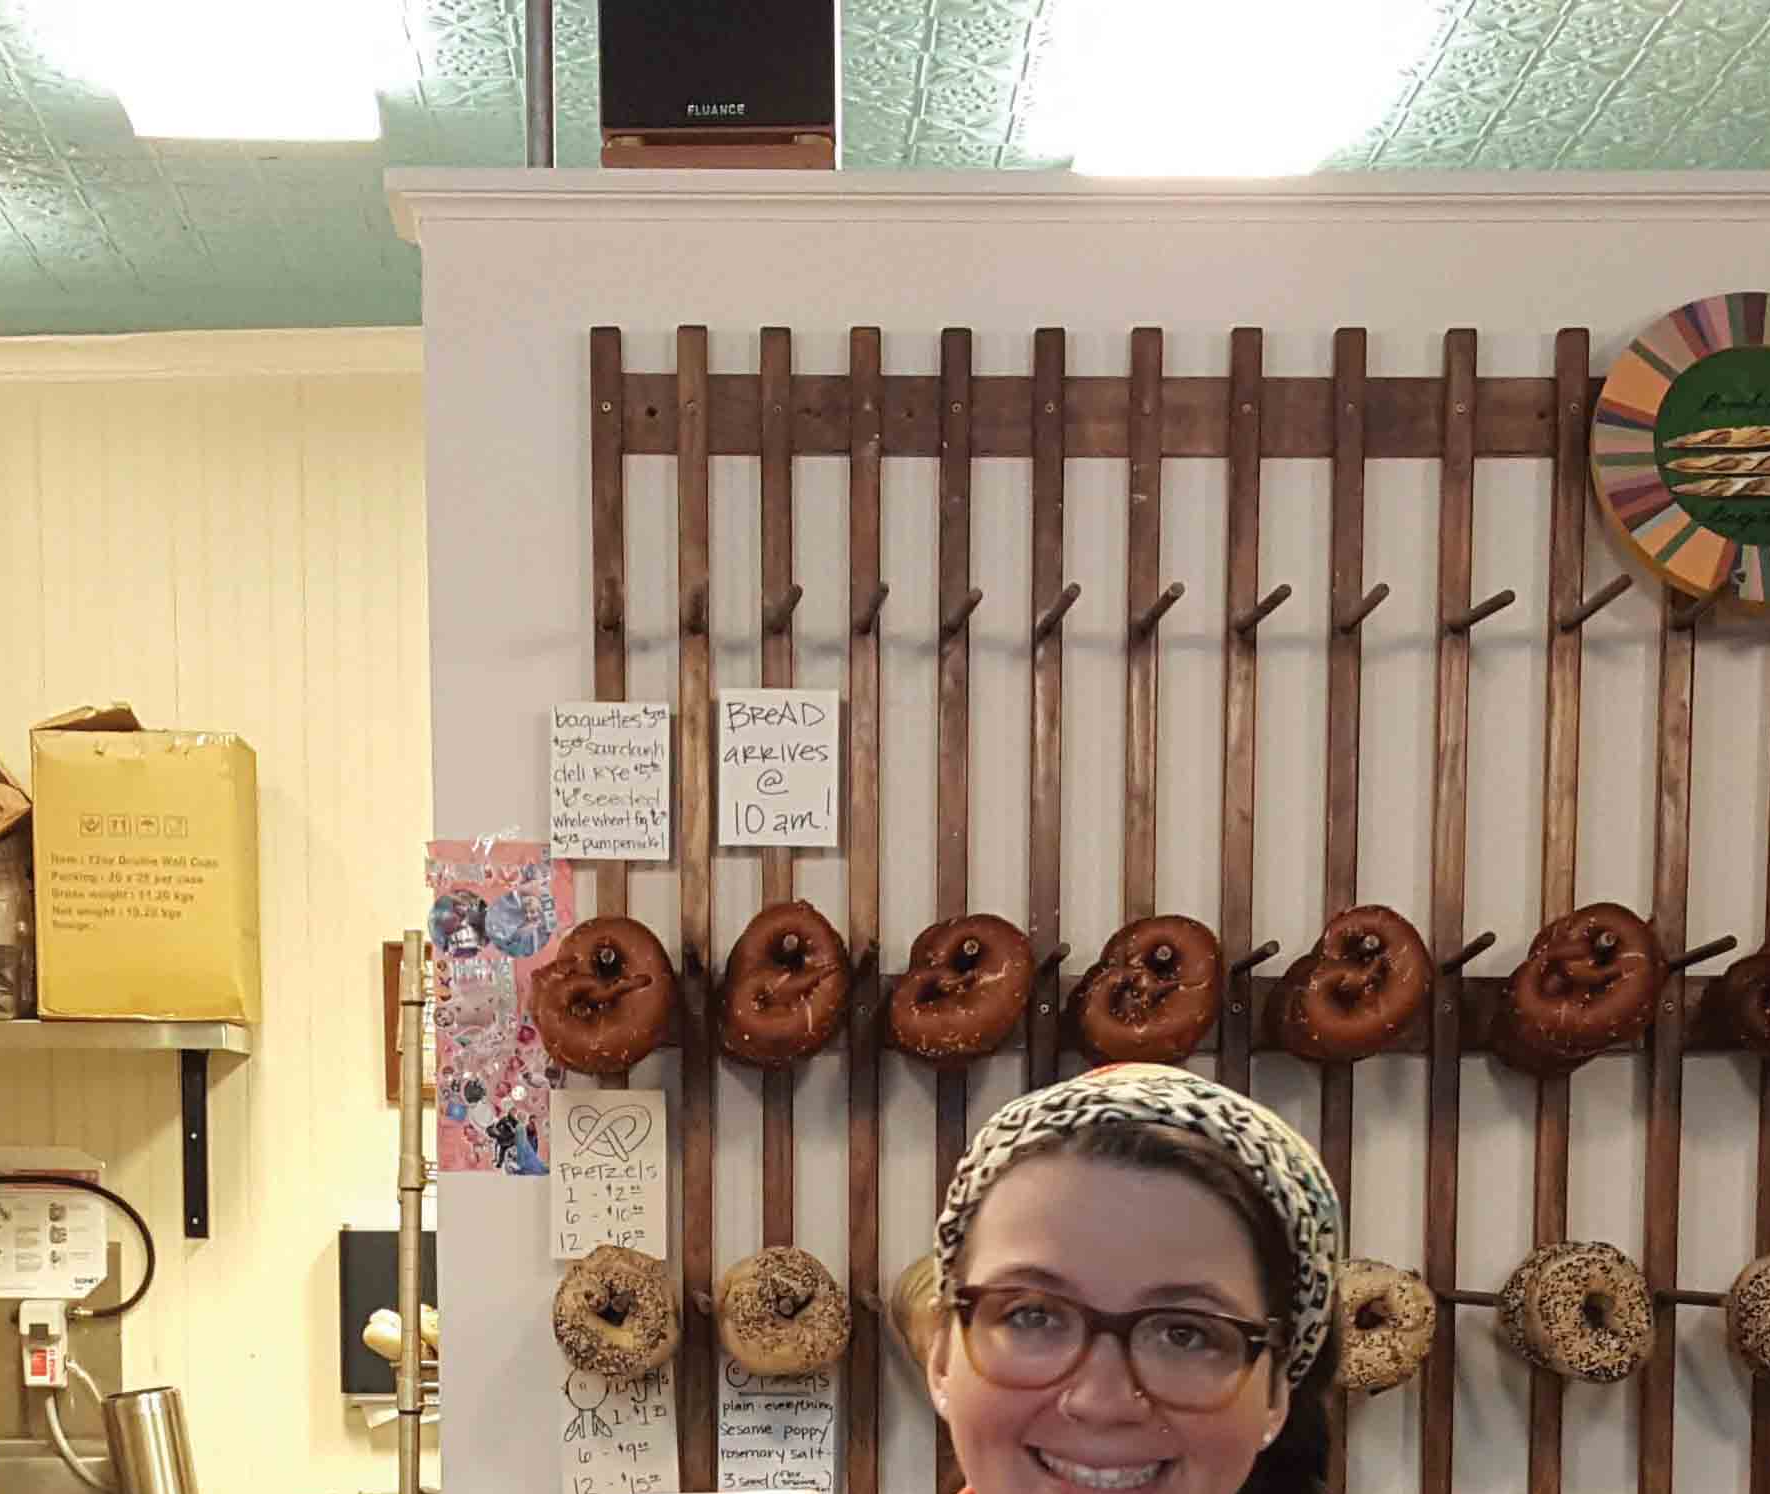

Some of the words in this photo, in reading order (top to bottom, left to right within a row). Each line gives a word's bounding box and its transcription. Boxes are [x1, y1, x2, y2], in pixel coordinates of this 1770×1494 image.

[686, 102, 746, 117] FLUANCE
[755, 768, 790, 796] @
[733, 800, 767, 836] 10
[559, 1231, 583, 1252] 12
[722, 1399, 755, 1417] plain
[783, 1424, 829, 1445] poppy
[720, 1446, 786, 1465] rosemary
